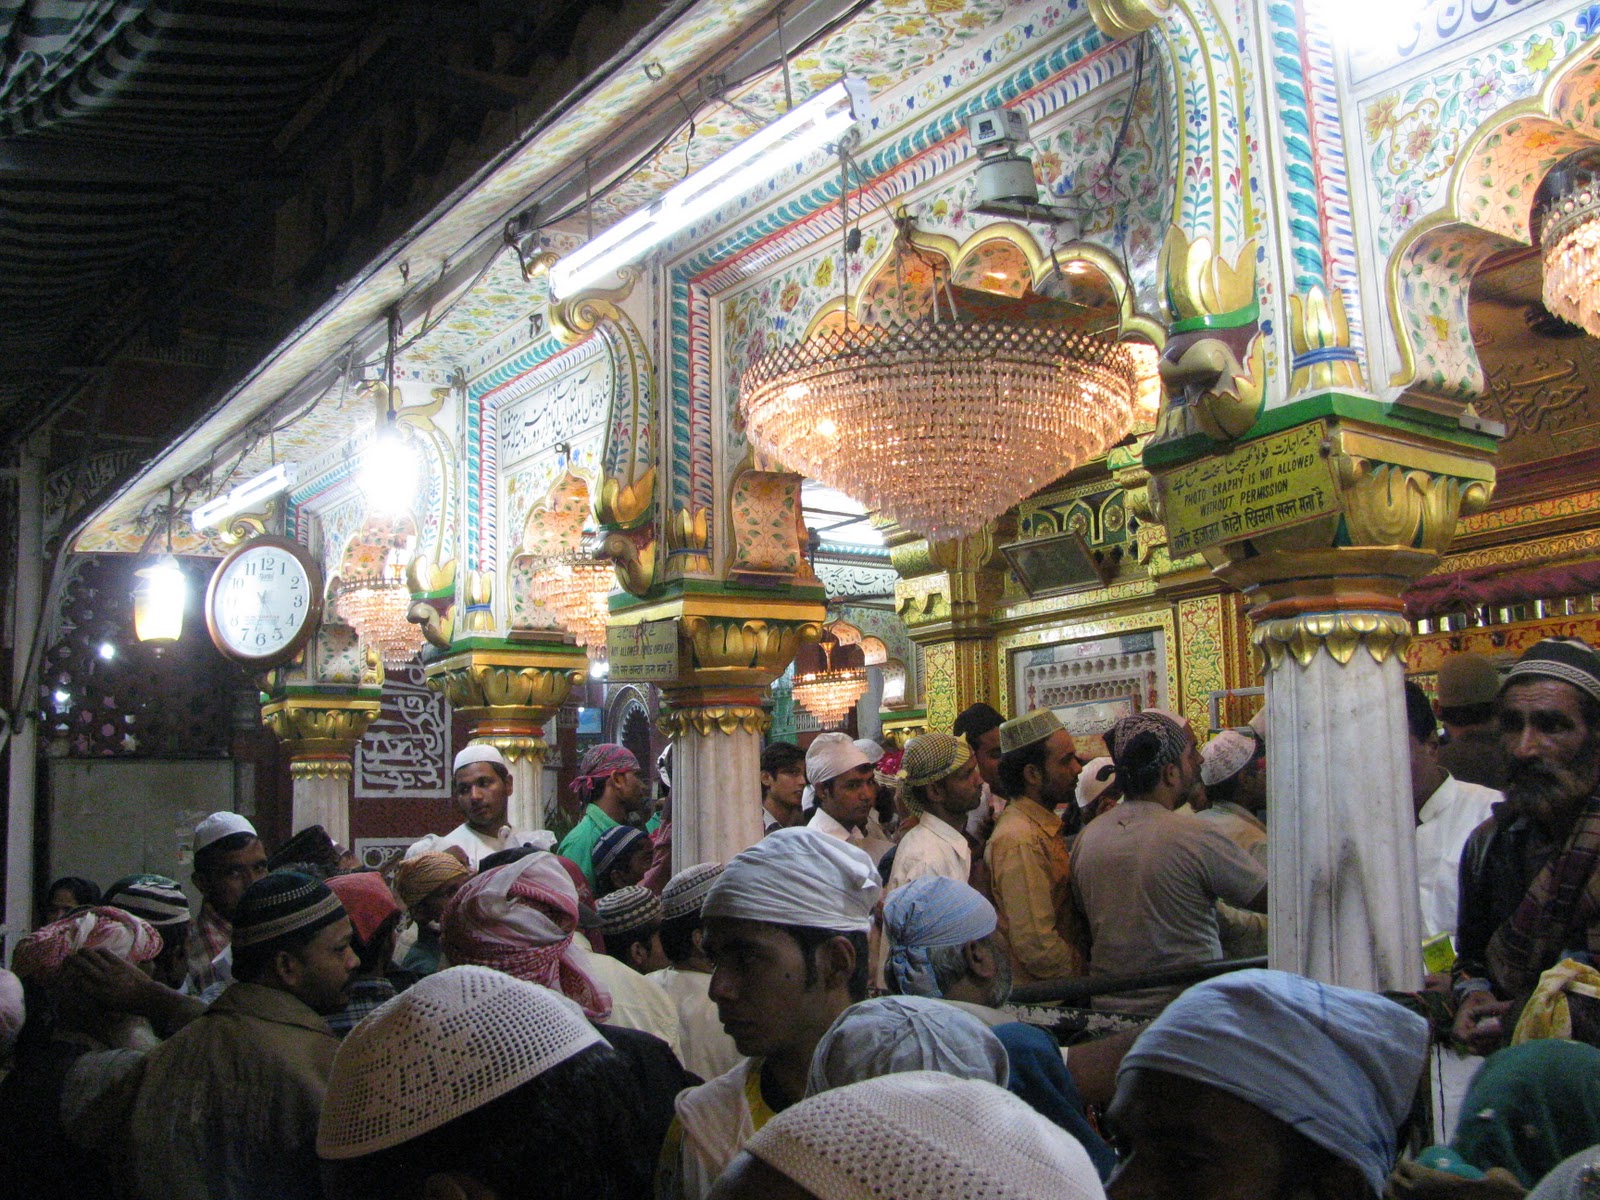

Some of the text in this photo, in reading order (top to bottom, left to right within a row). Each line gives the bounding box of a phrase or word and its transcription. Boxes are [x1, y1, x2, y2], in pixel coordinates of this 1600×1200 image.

[1184, 453, 1314, 508] PHOTO GRAPHY IS NOT ALLOWED
[1200, 479, 1288, 517] WITHOUT PERMISSION
[245, 562, 256, 576] 11
[261, 557, 275, 571] 12
[280, 562, 286, 575] 1
[290, 576, 300, 590] 2
[293, 594, 303, 608] 3
[286, 613, 294, 627] 4
[241, 628, 250, 641] 7
[255, 632, 266, 647] 6
[272, 627, 284, 641] 5
